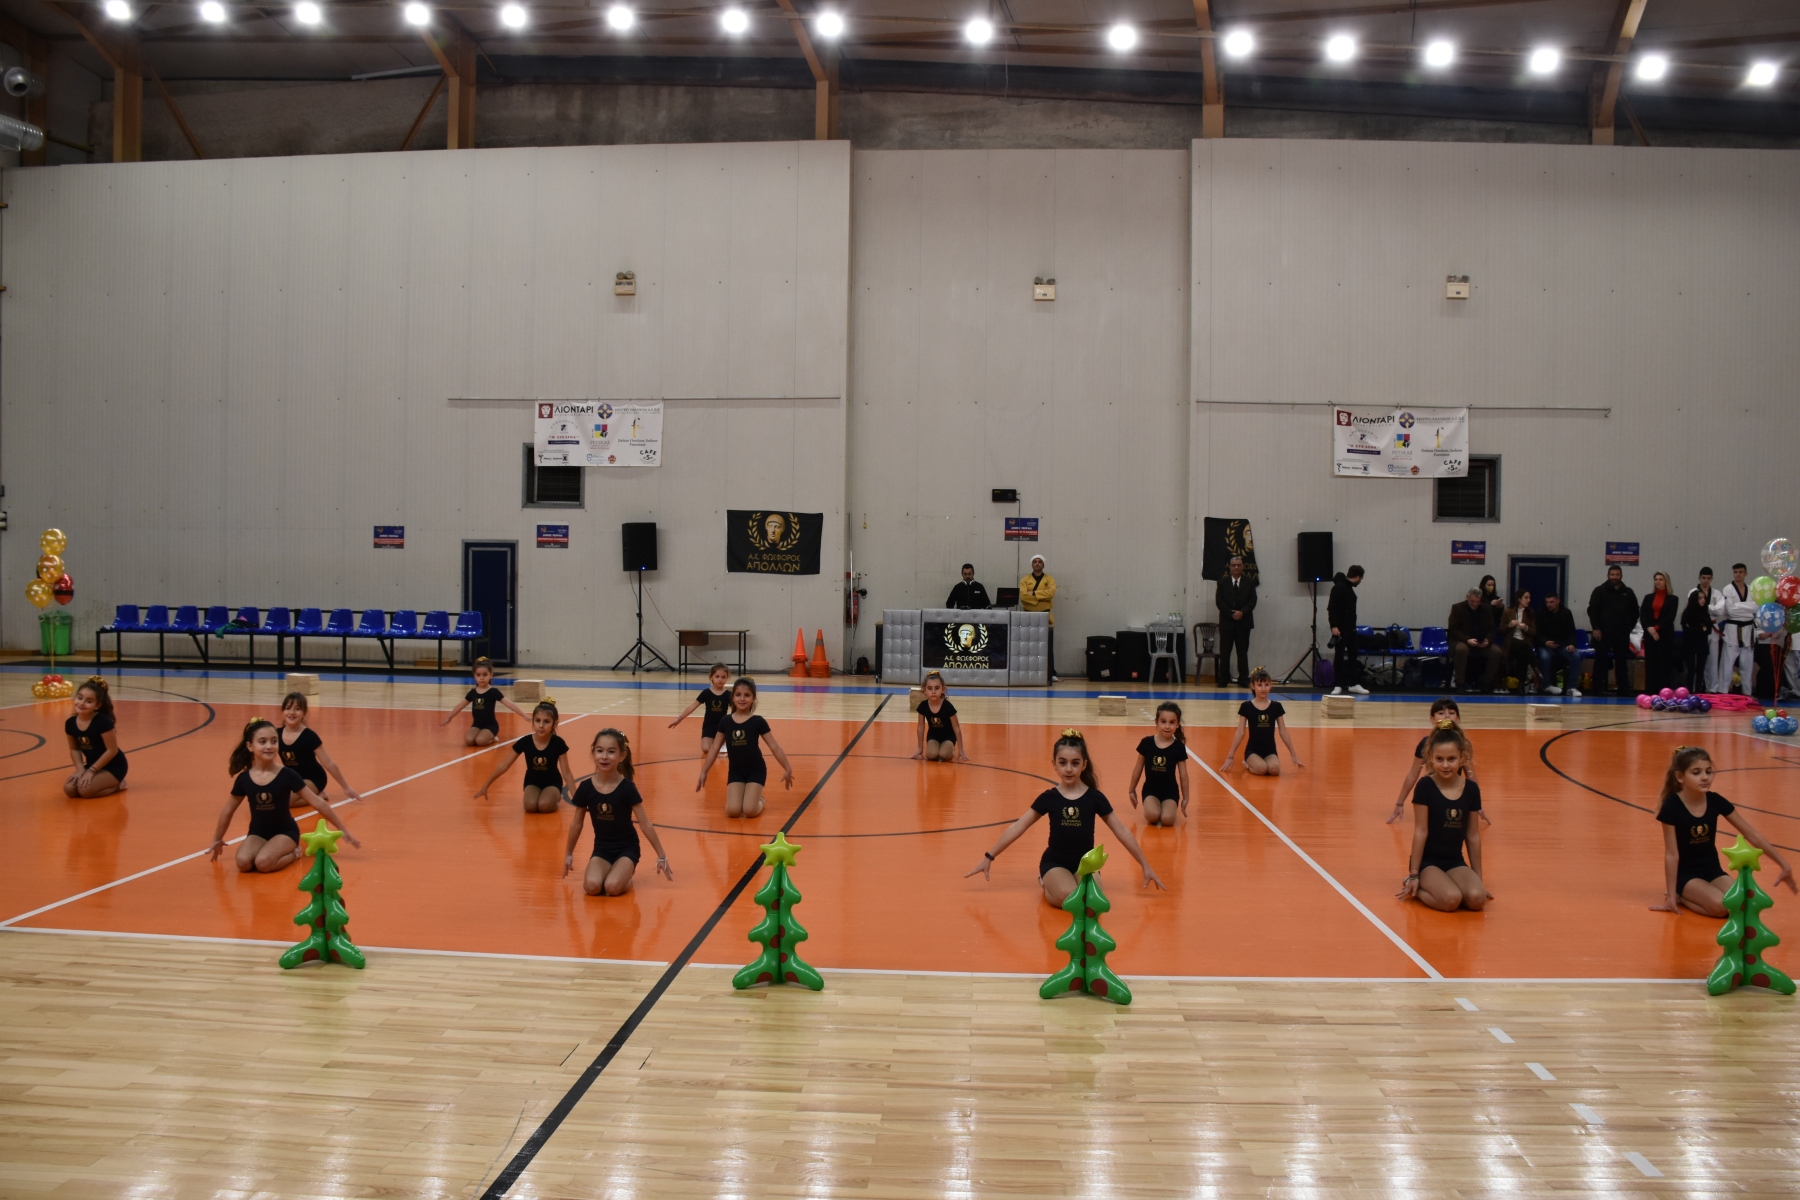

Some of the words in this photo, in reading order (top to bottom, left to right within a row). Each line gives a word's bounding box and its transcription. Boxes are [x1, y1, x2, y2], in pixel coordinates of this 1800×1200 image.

[554, 405, 594, 414] ΛΙΟΝΤΑΡΙ
[1352, 415, 1395, 425] ΛΙΟΝΤΑΡΙ
[746, 562, 801, 572] ΑΠΟΛΛΩΝ
